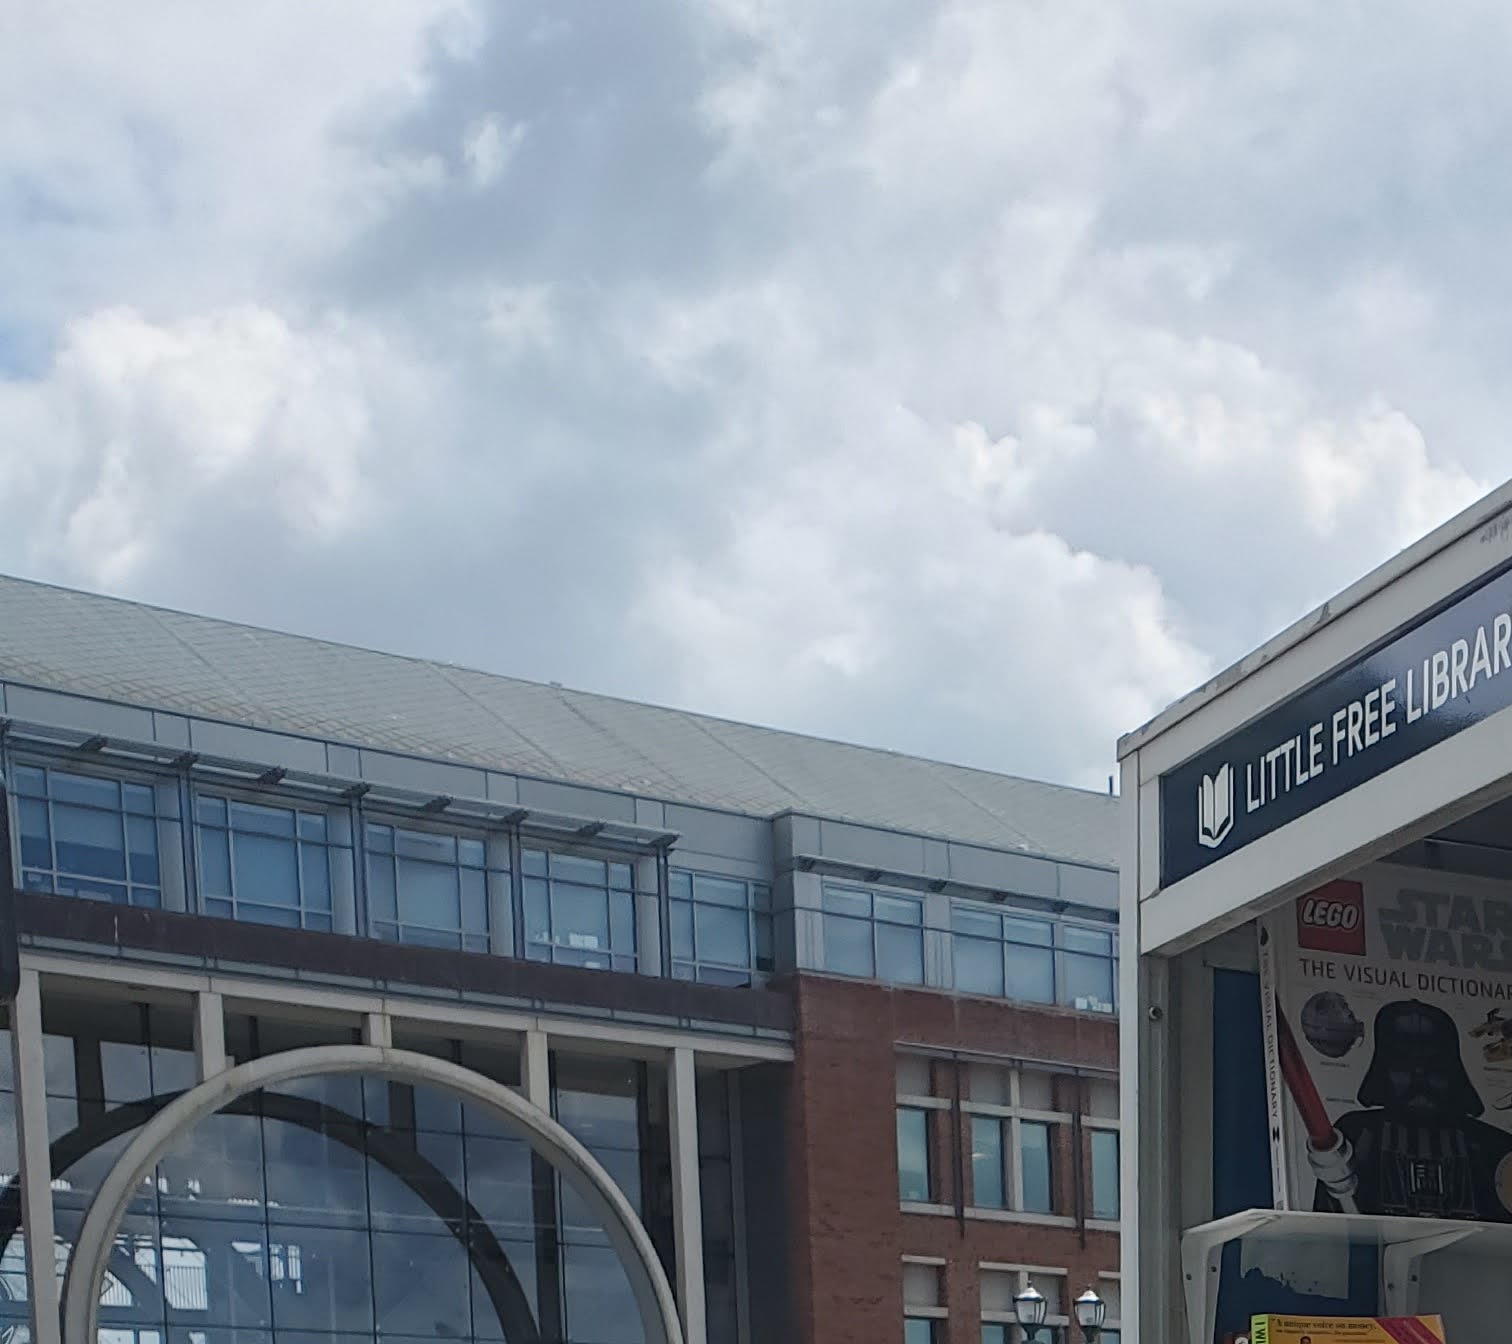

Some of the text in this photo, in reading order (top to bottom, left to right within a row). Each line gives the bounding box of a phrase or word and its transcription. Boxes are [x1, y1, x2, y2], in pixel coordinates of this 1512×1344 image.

[1245, 723, 1324, 812] LITTLE
[1332, 679, 1397, 766] FREE
[1302, 899, 1358, 930] LEGO
[1300, 959, 1336, 979] THE
[1343, 966, 1411, 989] VISUAL
[1266, 1031, 1279, 1119] DICTIONARY
